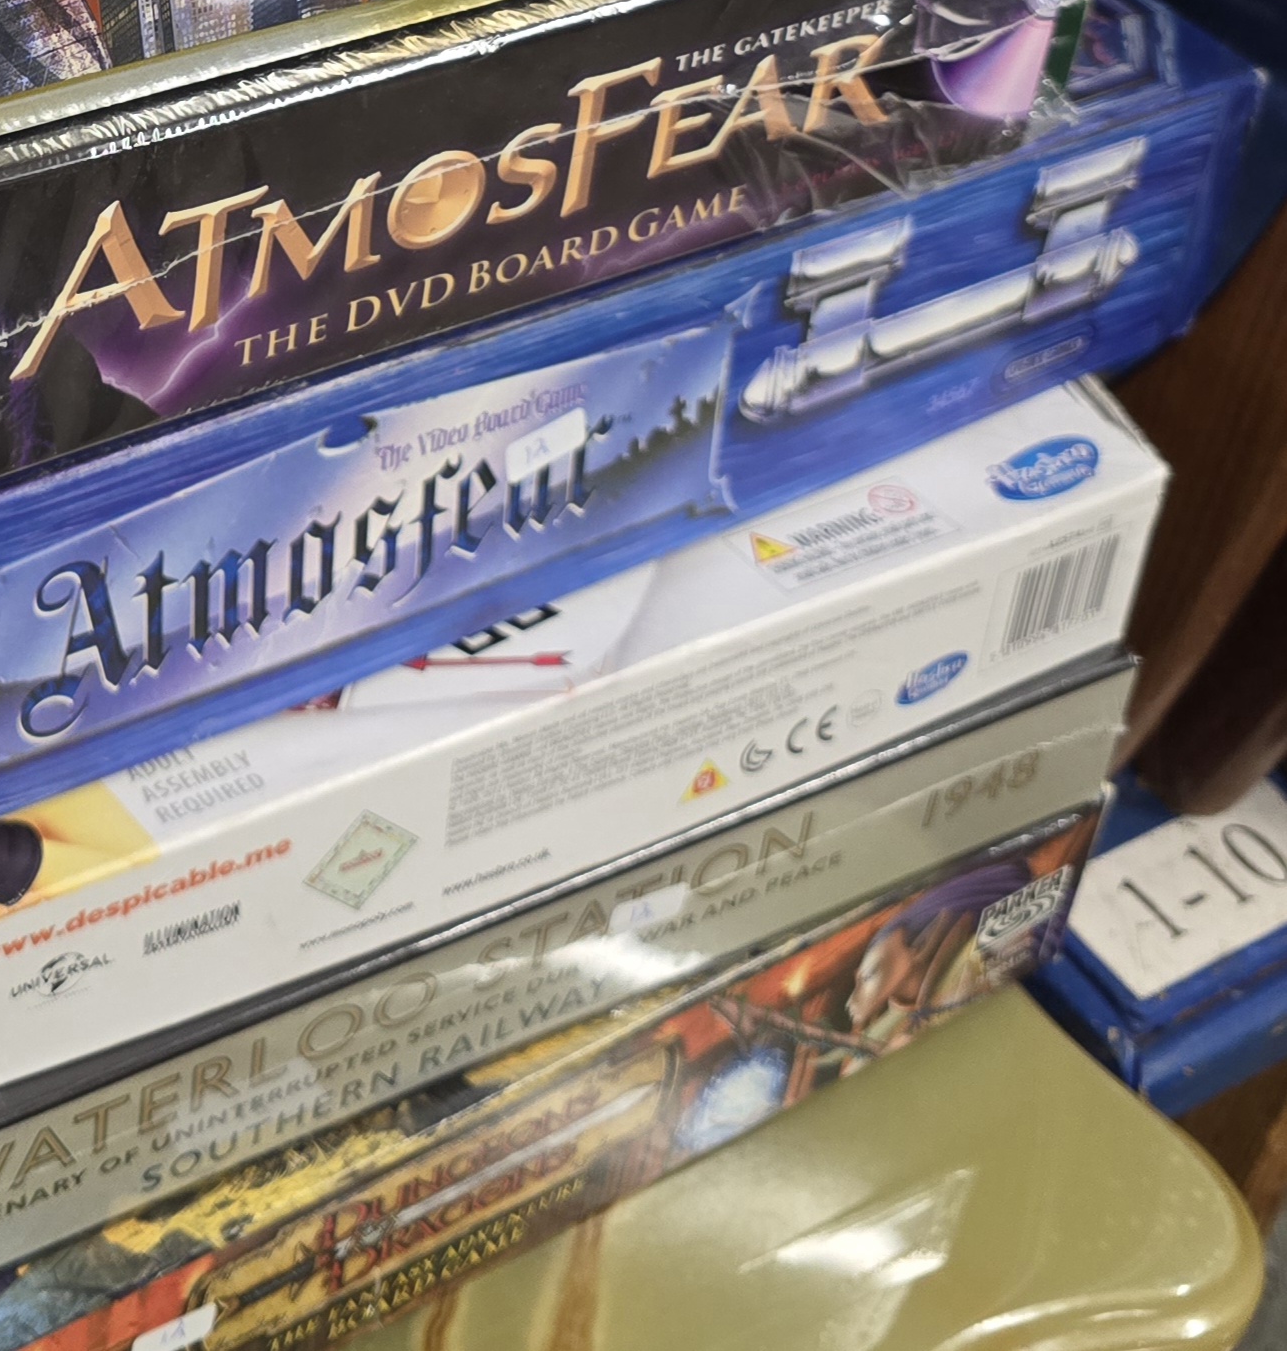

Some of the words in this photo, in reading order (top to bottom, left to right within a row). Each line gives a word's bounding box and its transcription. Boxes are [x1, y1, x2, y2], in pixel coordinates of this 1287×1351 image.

[675, 43, 726, 72] THE
[233, 314, 329, 368] THE
[345, 273, 458, 337] DVD
[466, 235, 619, 299] BOARD
[627, 186, 748, 255] GAME
[142, 749, 252, 803] ASSEMBLY
[155, 771, 266, 824] REQUIRED
[918, 749, 1041, 829] 1948
[1117, 823, 1287, 938] 1-10
[9, 952, 114, 999] UNIVERSAL
[97, 1145, 144, 1175] OF
[150, 1037, 398, 1151] UNINTERRUPTED
[404, 985, 520, 1045] SERVICE
[141, 1060, 400, 1195] SOUTHERN
[416, 976, 609, 1076] RAILWAY
